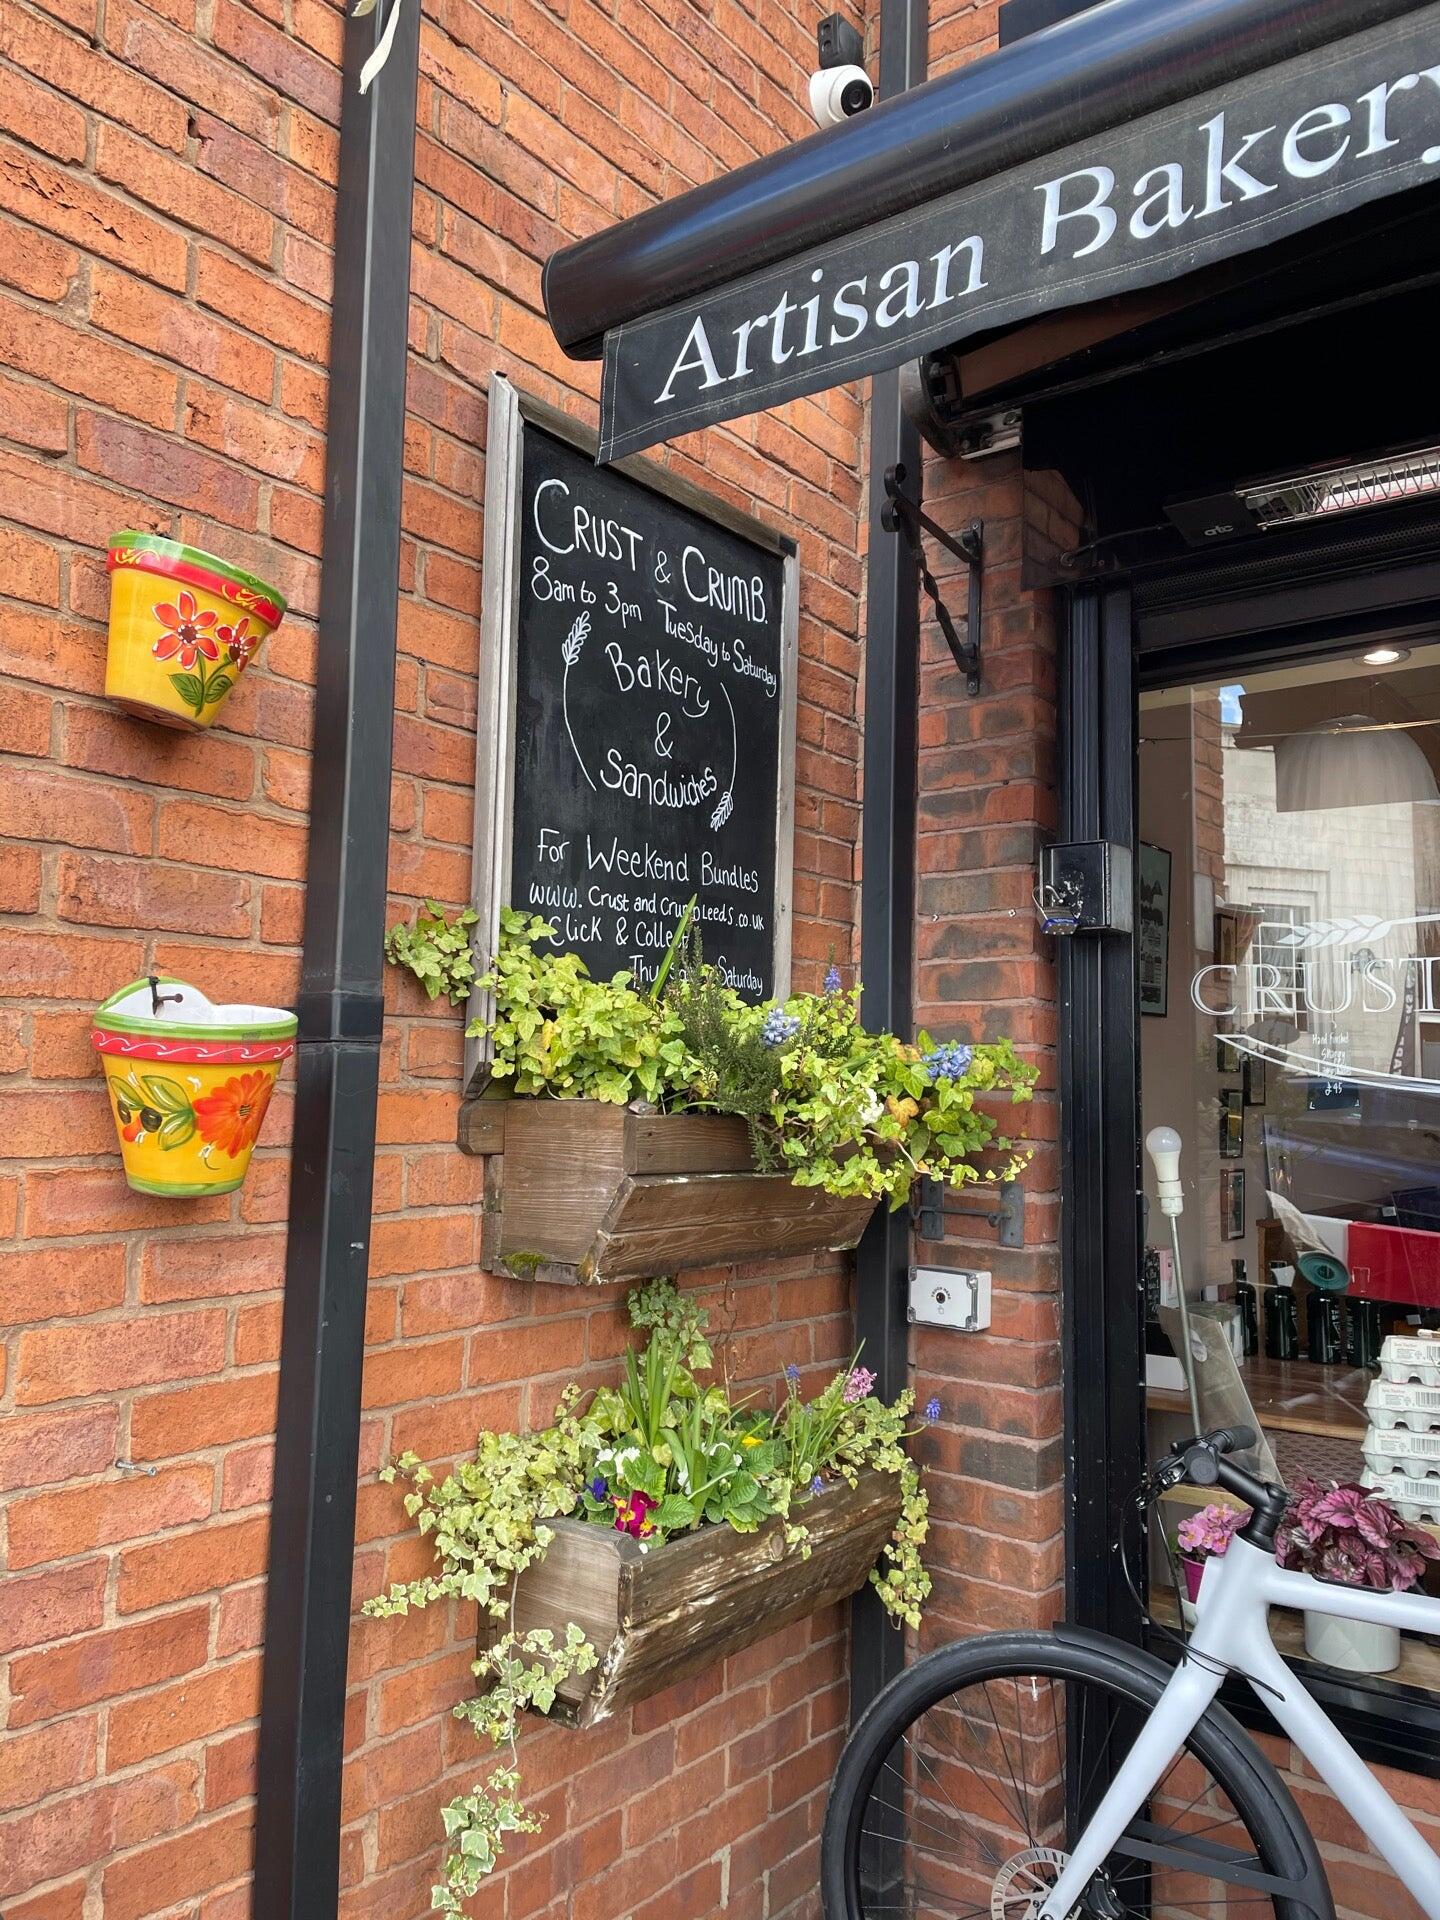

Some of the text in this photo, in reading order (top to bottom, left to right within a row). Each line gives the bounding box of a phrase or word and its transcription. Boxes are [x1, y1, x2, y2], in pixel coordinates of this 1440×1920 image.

[653, 65, 1440, 404] Artisan Baker
[534, 479, 643, 571] CRUST
[654, 551, 671, 583] &
[531, 556, 777, 698] 8am to 3pm Tuesday to Saturday
[605, 642, 709, 717] Bakery
[655, 712, 673, 759] &
[600, 748, 718, 808] Sandwiches
[537, 828, 759, 893] For Weekend Bundles
[548, 913, 690, 949] Click & Collet
[718, 955, 763, 996] Saturday
